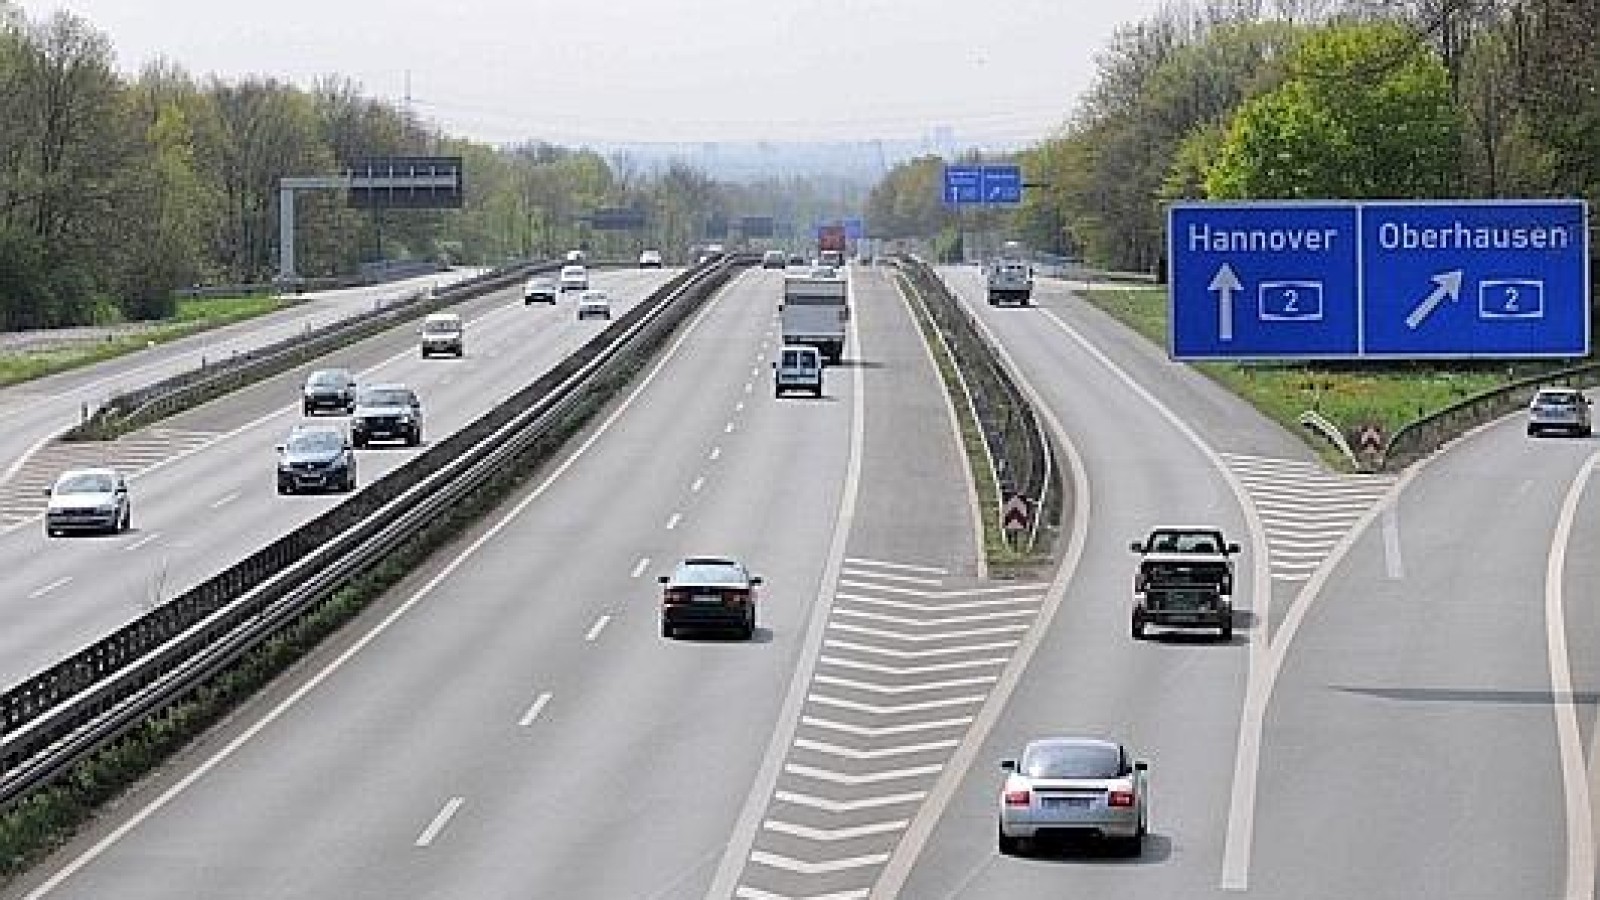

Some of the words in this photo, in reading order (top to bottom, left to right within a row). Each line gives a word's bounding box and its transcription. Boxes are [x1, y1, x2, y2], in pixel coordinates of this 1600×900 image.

[1188, 223, 1337, 252] Hannover
[1378, 221, 1568, 249] Oberhausen
[1282, 289, 1299, 312] 2
[1503, 286, 1520, 311] 2
